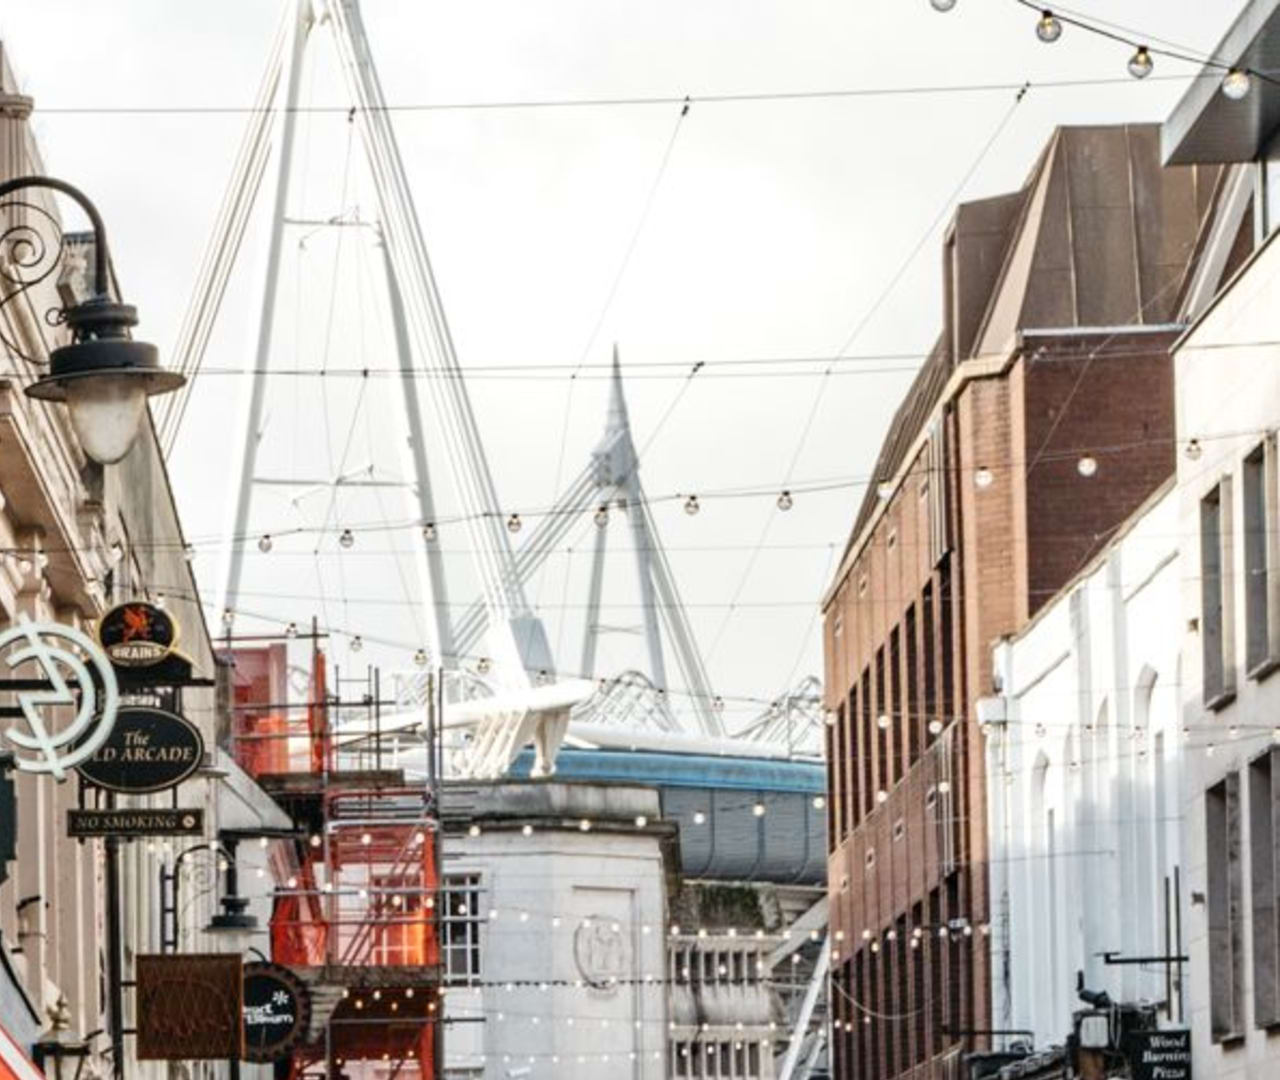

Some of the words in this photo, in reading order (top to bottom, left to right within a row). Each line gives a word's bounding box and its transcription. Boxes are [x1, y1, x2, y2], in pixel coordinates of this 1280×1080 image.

[124, 730, 151, 745] The
[92, 747, 116, 762] LD
[120, 746, 194, 762] ARCADE
[76, 817, 99, 829] NO
[103, 815, 177, 829] SMOKING
